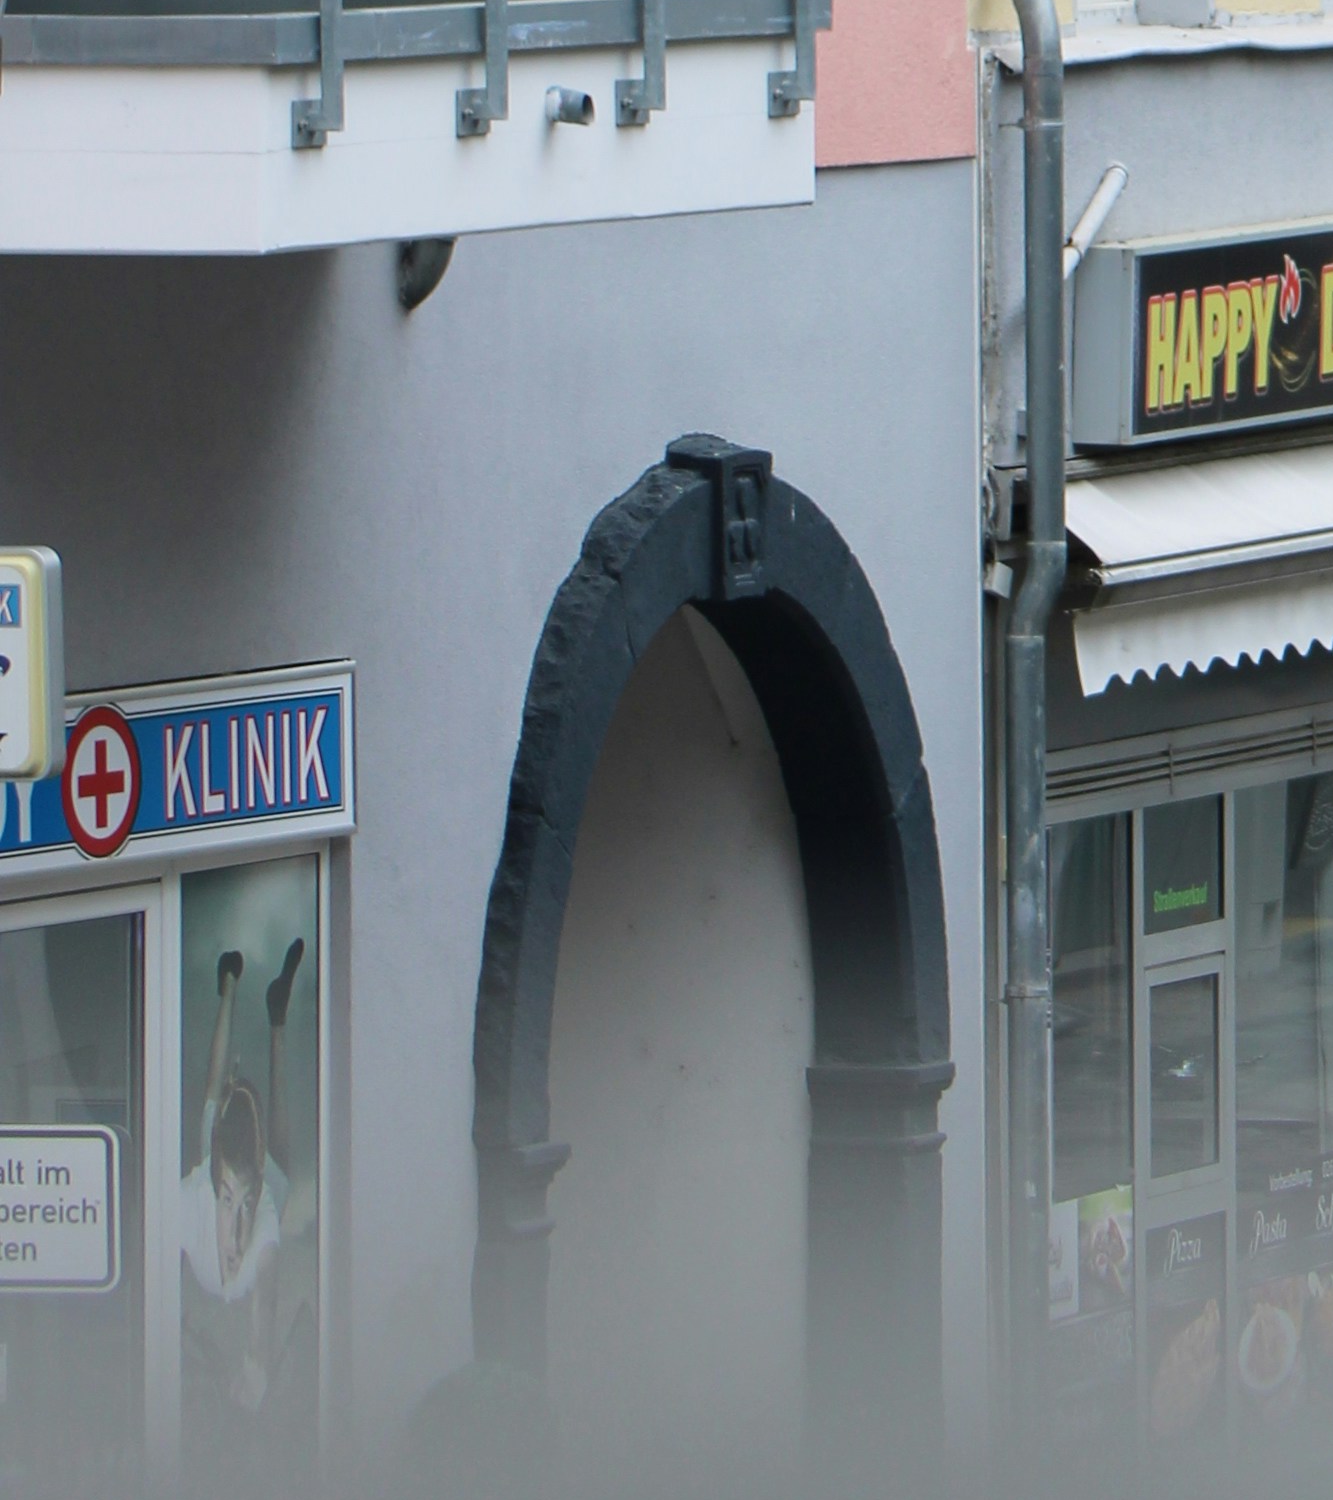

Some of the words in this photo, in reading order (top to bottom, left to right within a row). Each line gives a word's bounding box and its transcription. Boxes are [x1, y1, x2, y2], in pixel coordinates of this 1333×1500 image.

[1145, 274, 1279, 417] HAPPY
[163, 704, 329, 821] KLINIK
[37, 1159, 70, 1185] im
[1164, 1228, 1202, 1279] Pizza
[1249, 1210, 1288, 1260] Pasta
